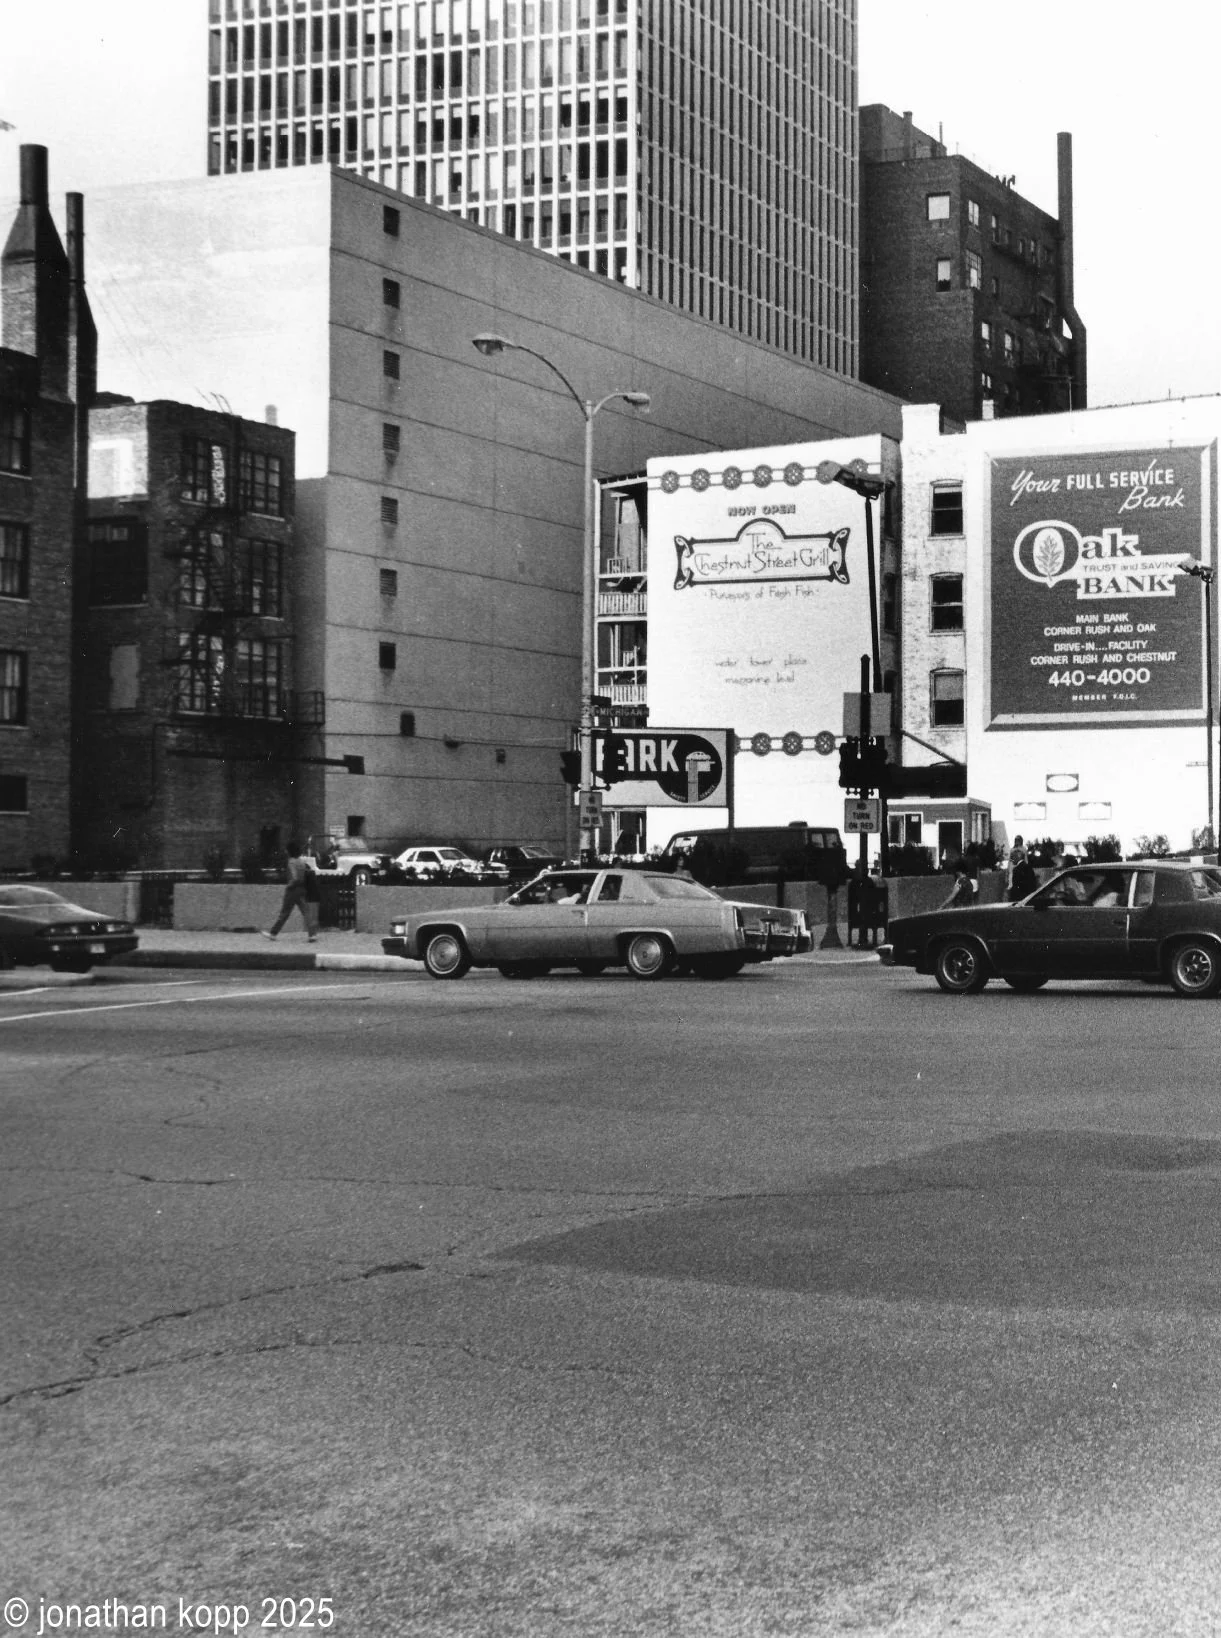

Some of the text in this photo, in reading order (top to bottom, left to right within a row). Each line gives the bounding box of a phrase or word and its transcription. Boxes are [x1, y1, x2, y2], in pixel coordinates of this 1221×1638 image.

[1010, 459, 1174, 506] Your FULL SERVICE
[1118, 485, 1184, 513] Bank
[728, 504, 796, 516] NOW OPEN
[746, 532, 782, 553] The
[694, 547, 829, 576] Chestnut Street Grill
[1083, 560, 1180, 573] TRUST and SAVING
[755, 586, 764, 598] of
[1083, 575, 1170, 595] BANK
[1076, 613, 1129, 623] MAIN BANK
[1044, 623, 1157, 636] CORNER RUSH AND OAK
[1030, 651, 1177, 665] CORNER RUSH AND CHESTNUT
[1048, 667, 1151, 687] 440-4000
